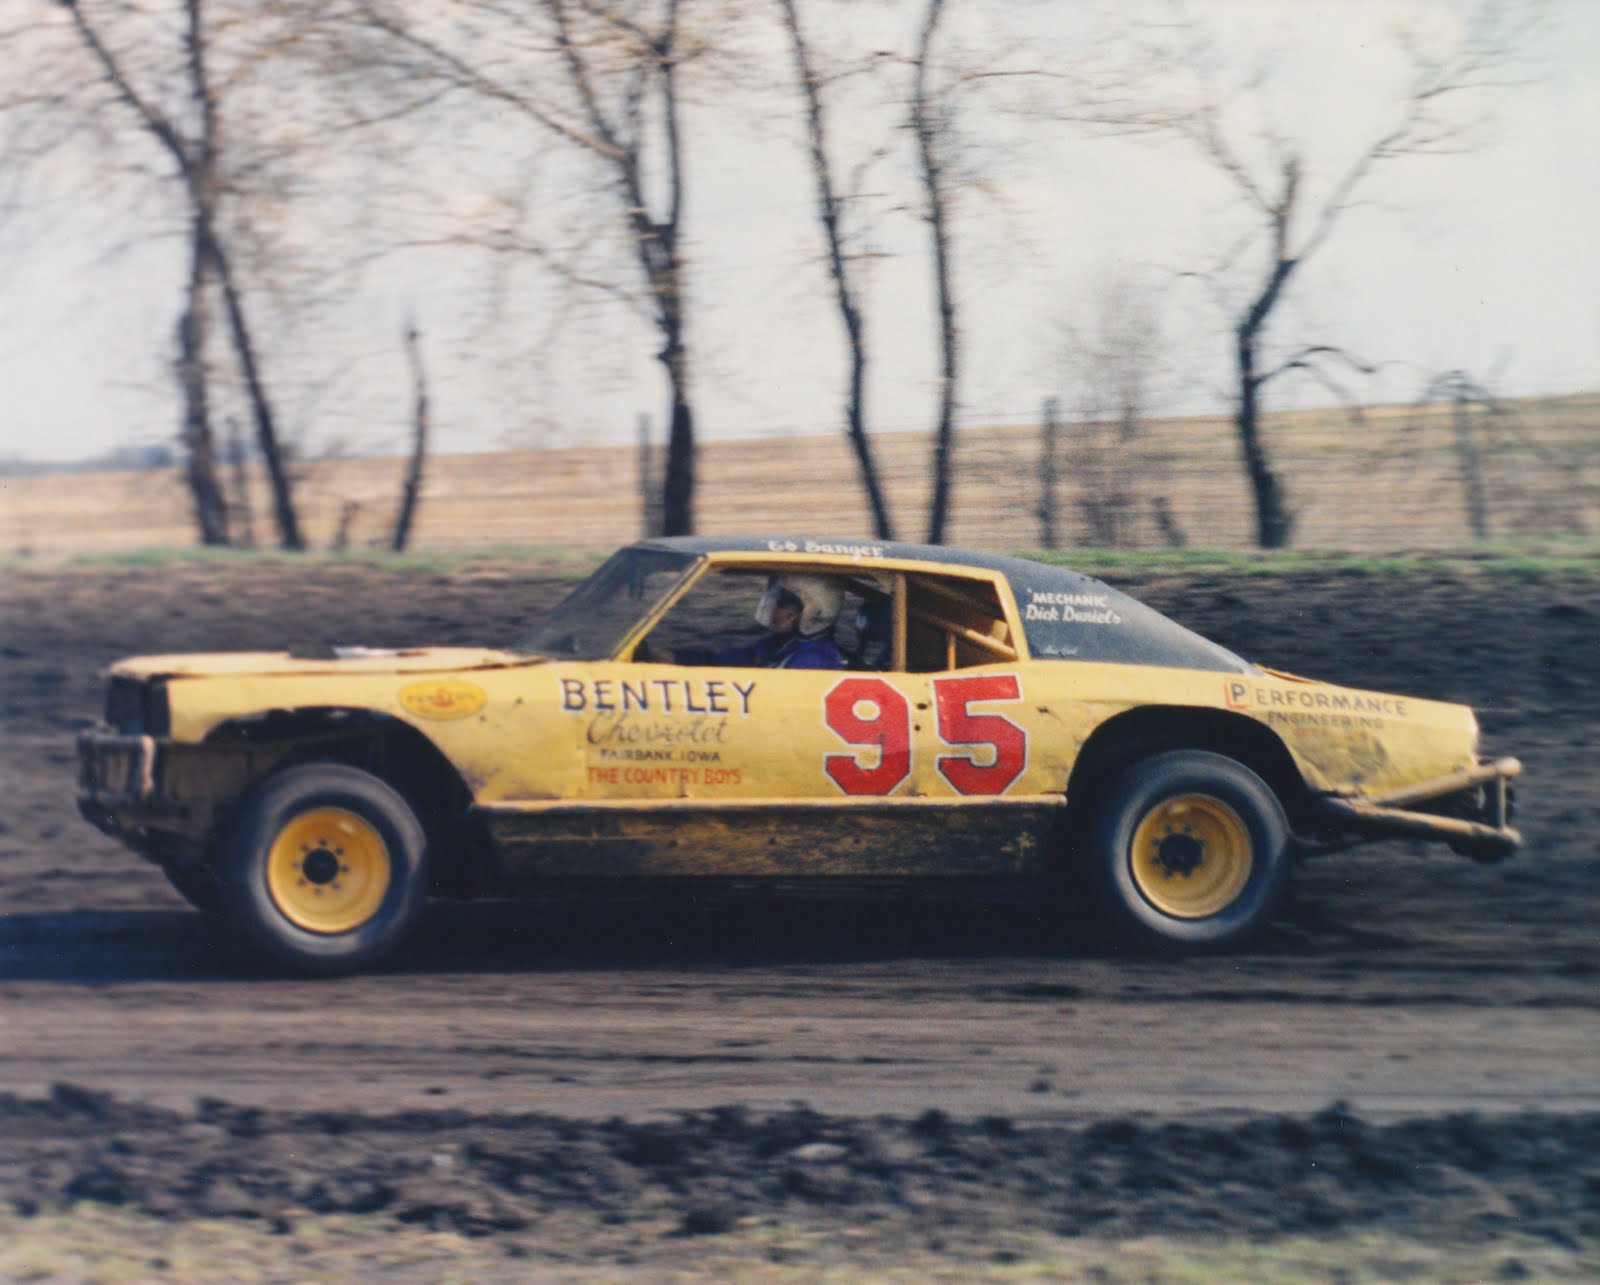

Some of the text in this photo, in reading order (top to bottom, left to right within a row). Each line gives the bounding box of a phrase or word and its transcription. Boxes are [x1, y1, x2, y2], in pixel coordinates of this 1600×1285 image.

[1025, 603, 1059, 621] Dick
[560, 678, 756, 714] BENTLEY
[1230, 682, 1408, 717] PERFORMANCE
[586, 712, 729, 745] Chevrolet
[1268, 710, 1385, 729] ENGINEERING
[822, 673, 1028, 797] 95
[681, 750, 722, 762] IOWA
[587, 766, 743, 785] THE COUNTRY BOYS
